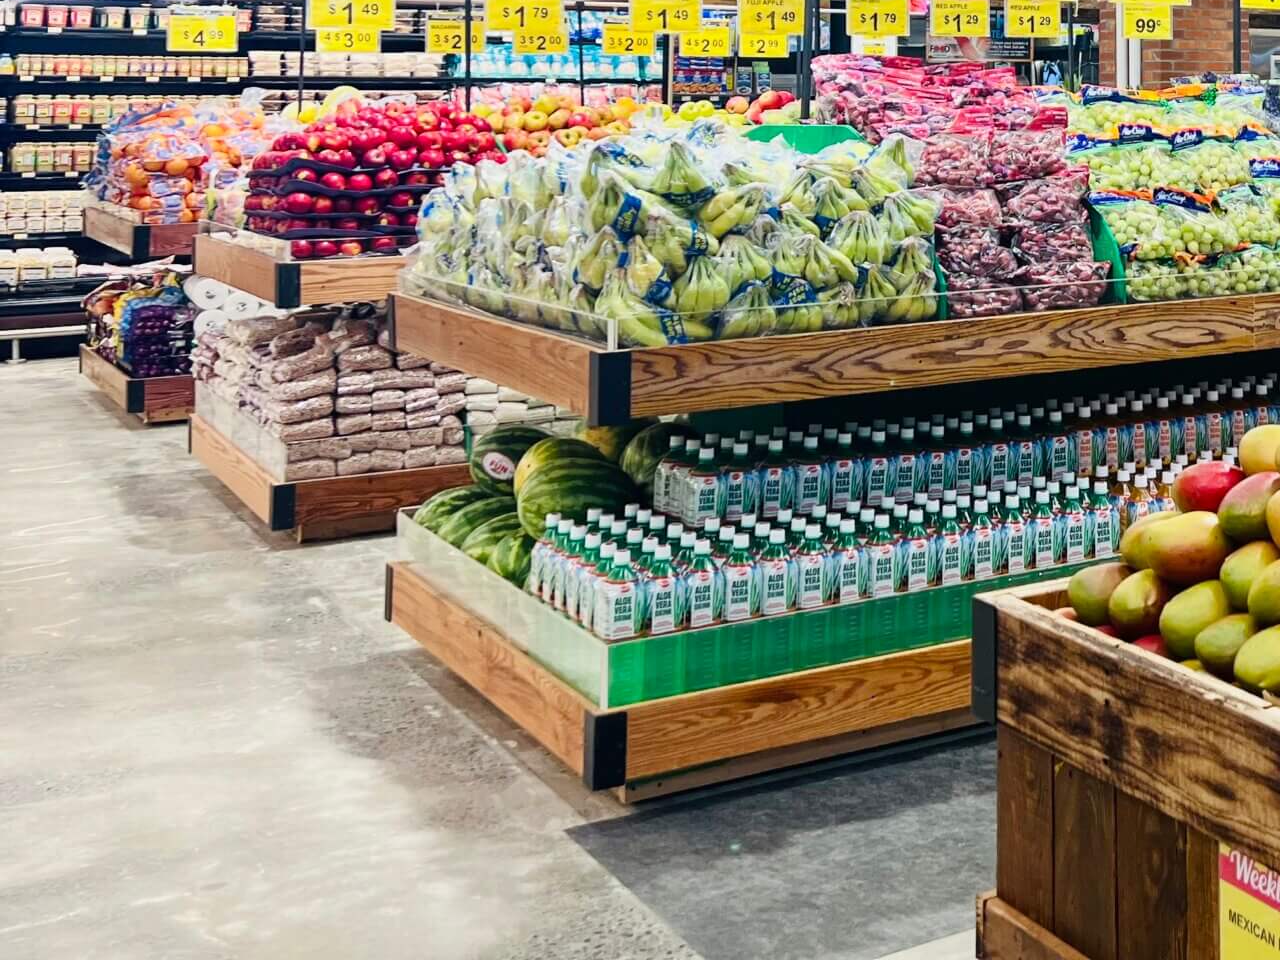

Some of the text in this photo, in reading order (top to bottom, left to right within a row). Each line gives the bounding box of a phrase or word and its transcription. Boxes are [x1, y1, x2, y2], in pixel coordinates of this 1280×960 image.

[804, 568, 820, 577] ALOE
[768, 574, 785, 583] ALOE
[1228, 909, 1277, 947] MEXICAN
